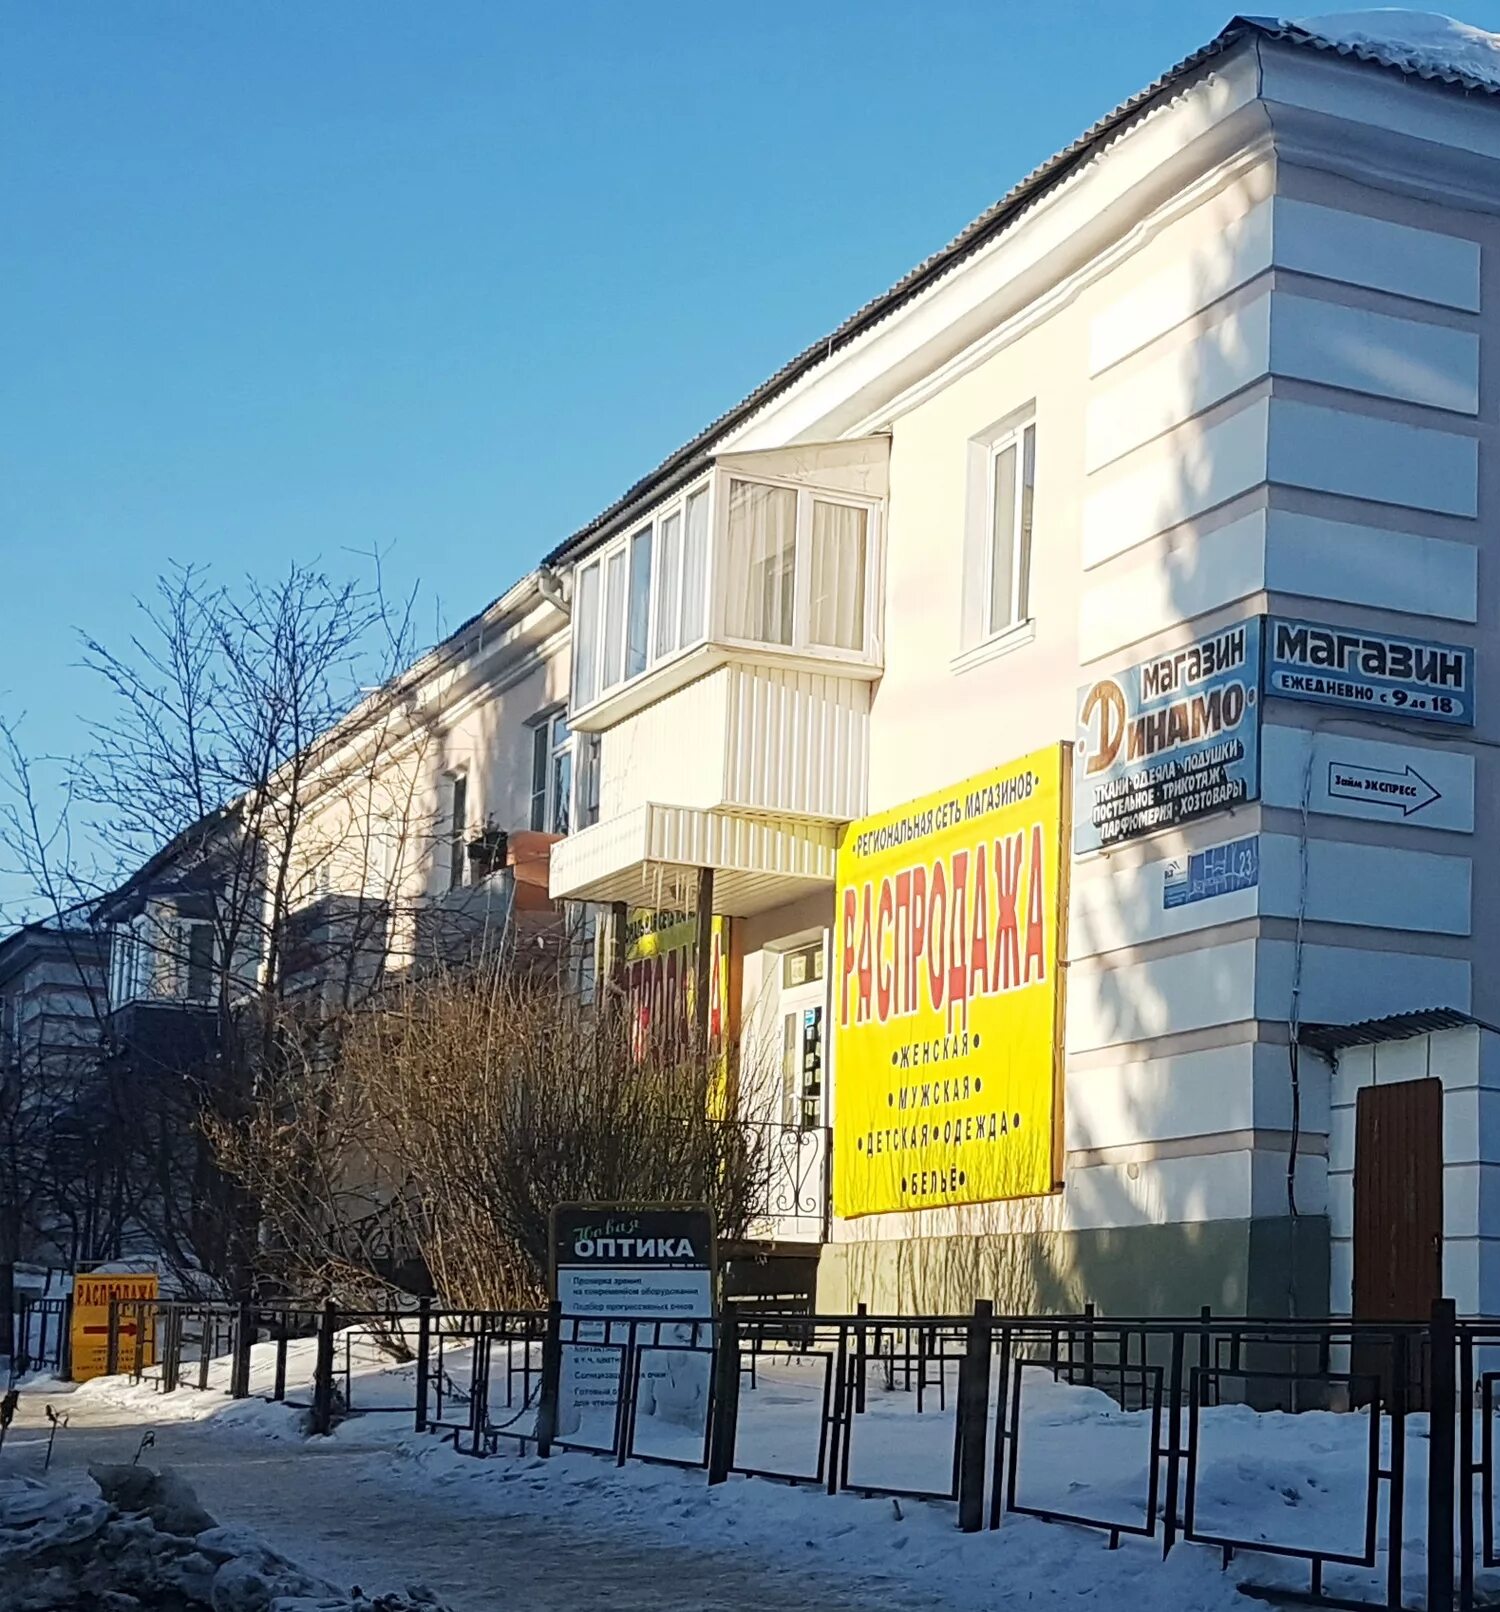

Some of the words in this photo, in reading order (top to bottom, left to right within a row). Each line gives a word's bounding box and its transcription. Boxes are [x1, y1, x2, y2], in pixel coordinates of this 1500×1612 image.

[1281, 675, 1373, 700] ЕЖЕДНЕВНО
[1392, 690, 1408, 705] 9
[1410, 698, 1426, 708] до
[1431, 697, 1453, 713] 18
[1096, 777, 1129, 802] ТКАНИ
[1134, 761, 1176, 789] ОДЕЯЛА
[1184, 739, 1238, 772] ПОДУШКИ
[1335, 775, 1362, 788] Займ
[1365, 779, 1416, 796] ЭКСПРЕСС
[857, 813, 933, 858] РЕГИОНАЛЬНАЯ
[936, 800, 961, 830] СЕТЬ
[965, 771, 1032, 819] МАГАЗИНОВ
[1093, 789, 1154, 822] ПОСТЕЛЬНОЕ
[1163, 767, 1220, 799] ТРИКОТАЖ
[1101, 802, 1173, 838] ПАРФЮМЕРИЯ
[1180, 779, 1242, 814] ХОЗТОВАРЫ
[1240, 850, 1252, 877] 23
[841, 826, 1044, 1034] РАСПРОДАЖА
[900, 1033, 968, 1068] ЖЕНСКАЯ
[899, 1076, 969, 1110] МУЖСКАЯ
[867, 1124, 928, 1158] ДЕТСКАЯ
[944, 1111, 1007, 1146] ОДЕЖДА
[574, 1238, 695, 1258] ОПТИКА
